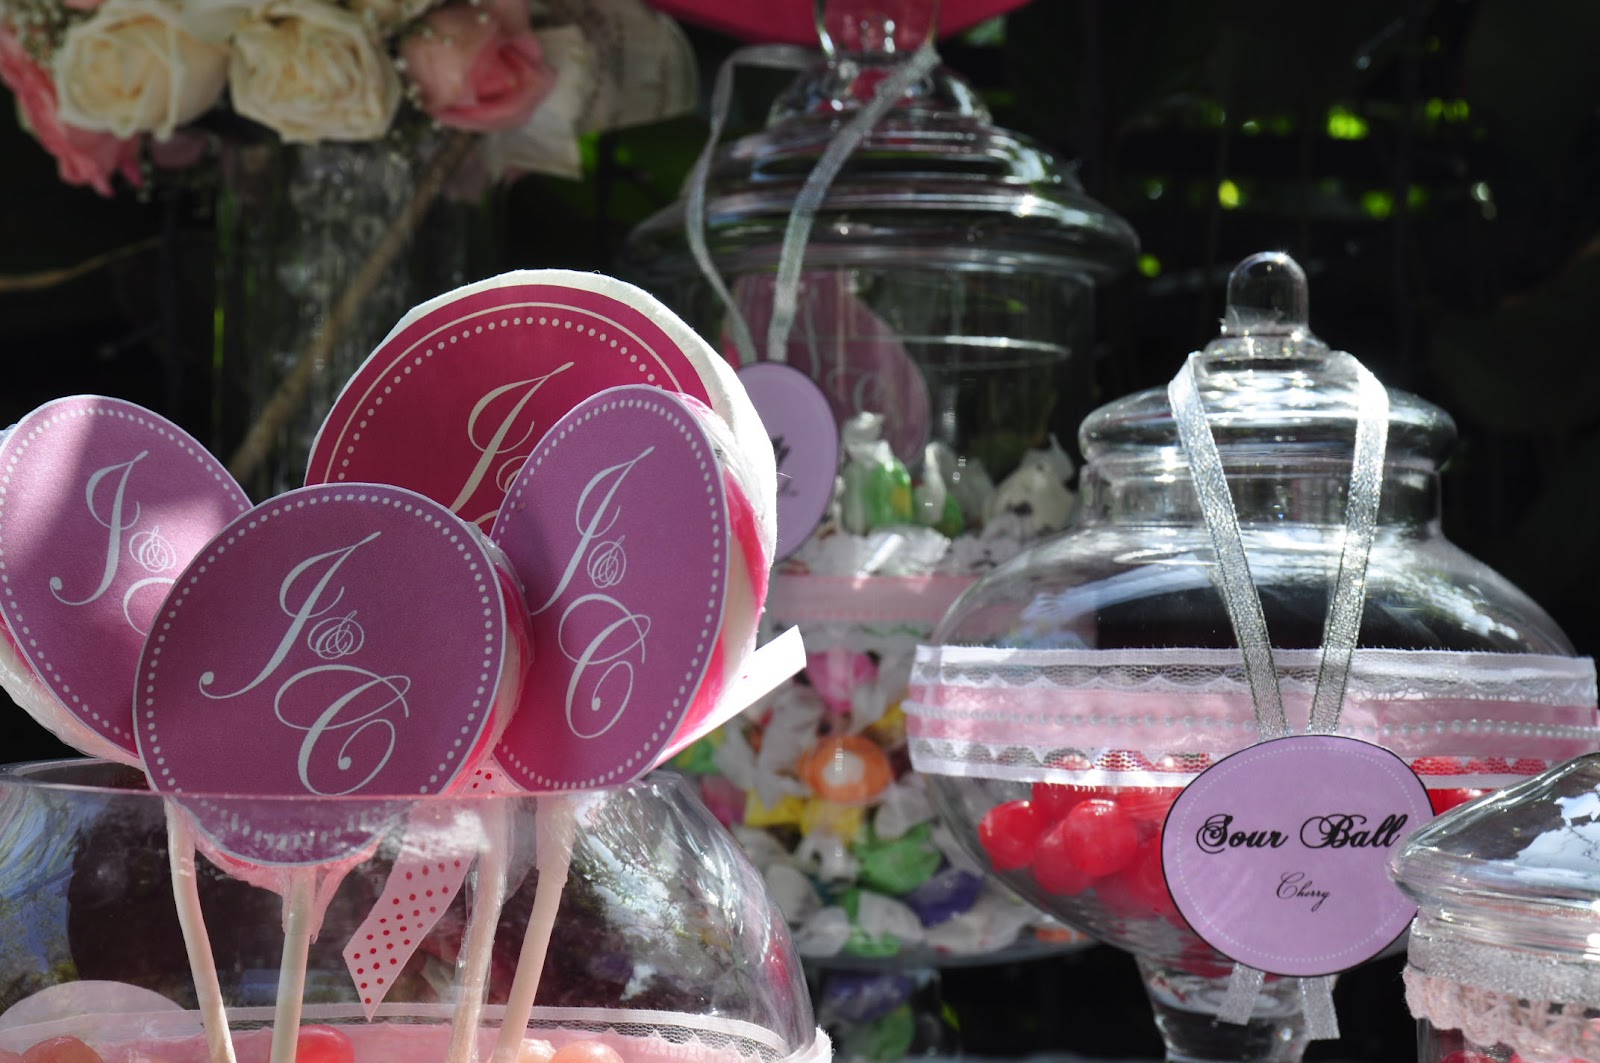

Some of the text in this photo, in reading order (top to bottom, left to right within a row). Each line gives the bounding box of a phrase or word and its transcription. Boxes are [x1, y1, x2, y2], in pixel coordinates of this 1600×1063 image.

[199, 530, 382, 700] J
[557, 592, 652, 740] C
[274, 664, 411, 797] C
[1195, 813, 1409, 855] Sour Ball
[1275, 871, 1331, 913] Cherry
